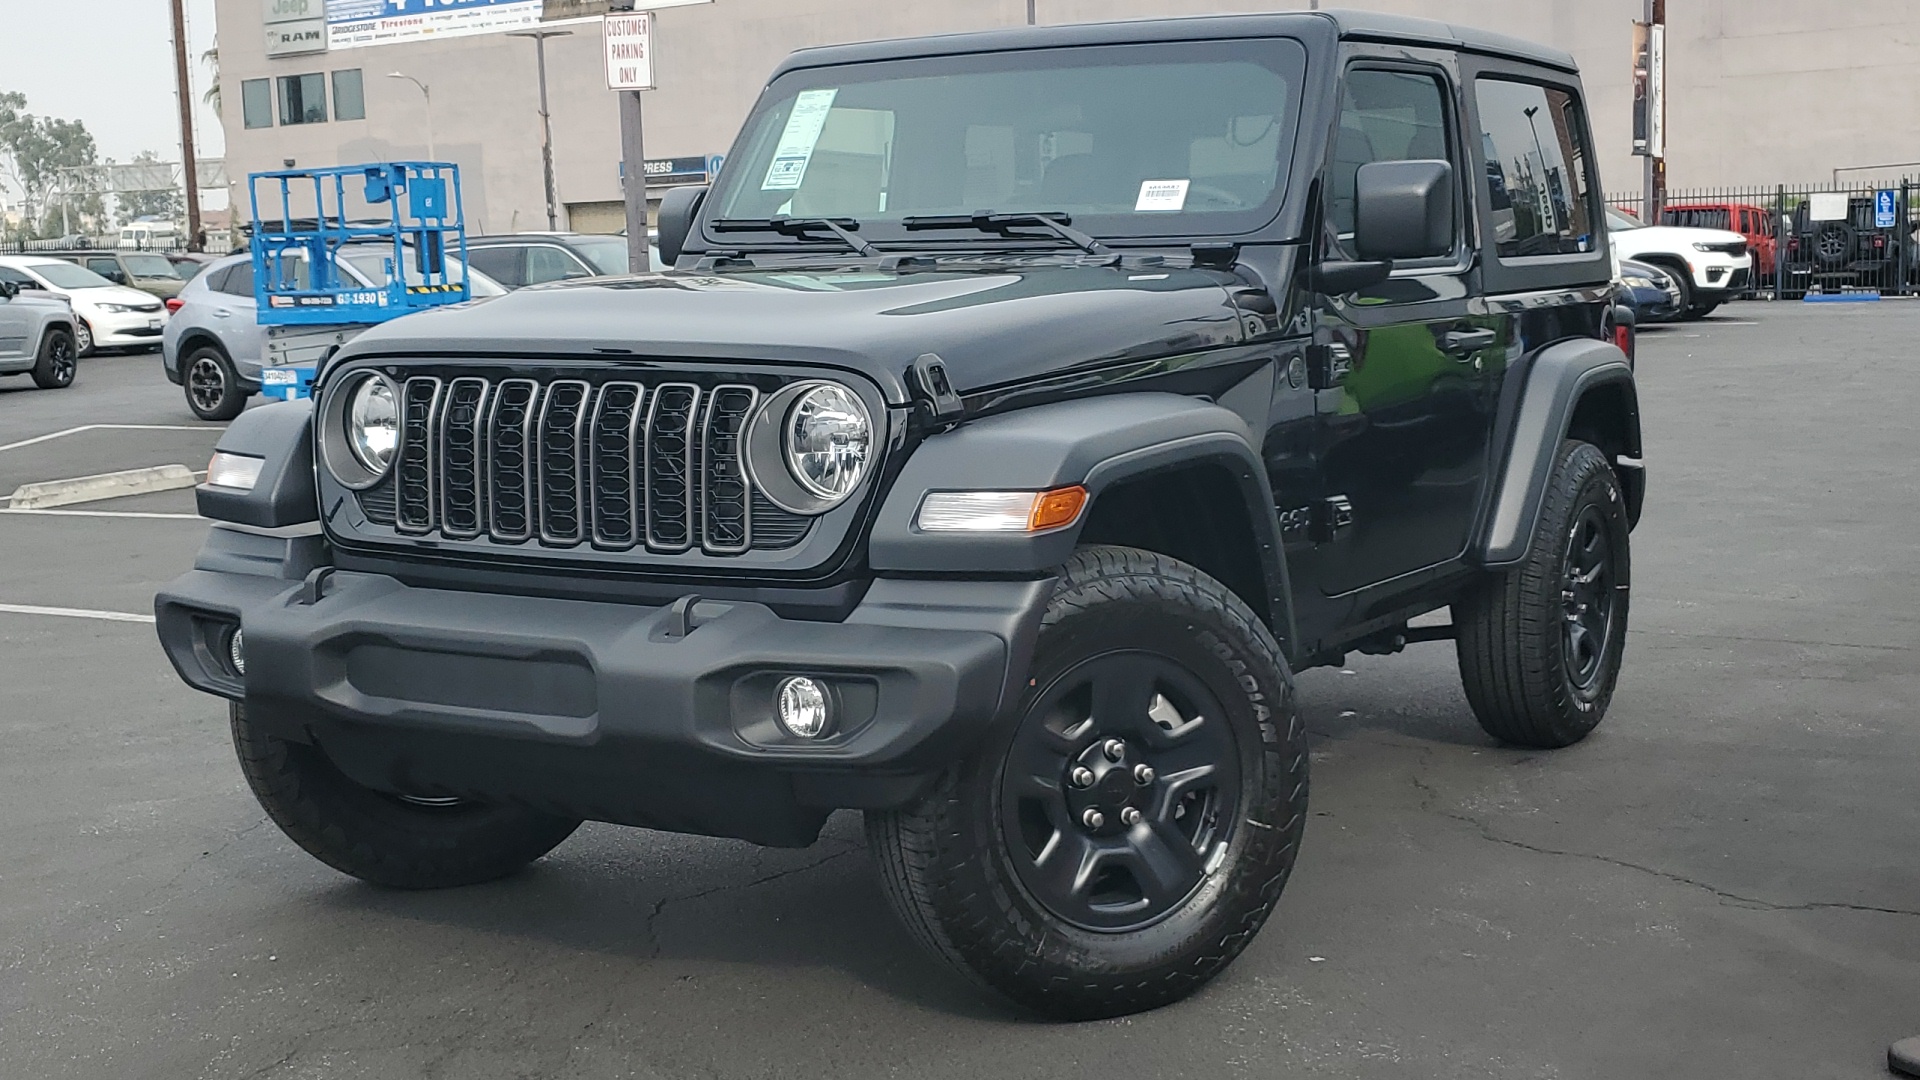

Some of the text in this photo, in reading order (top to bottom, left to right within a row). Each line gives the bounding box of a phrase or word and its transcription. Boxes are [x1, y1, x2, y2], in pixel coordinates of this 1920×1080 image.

[606, 19, 648, 37] CUSTOMER
[281, 31, 320, 43] RAM
[611, 43, 645, 60] PARKING
[619, 67, 638, 84] ONLY
